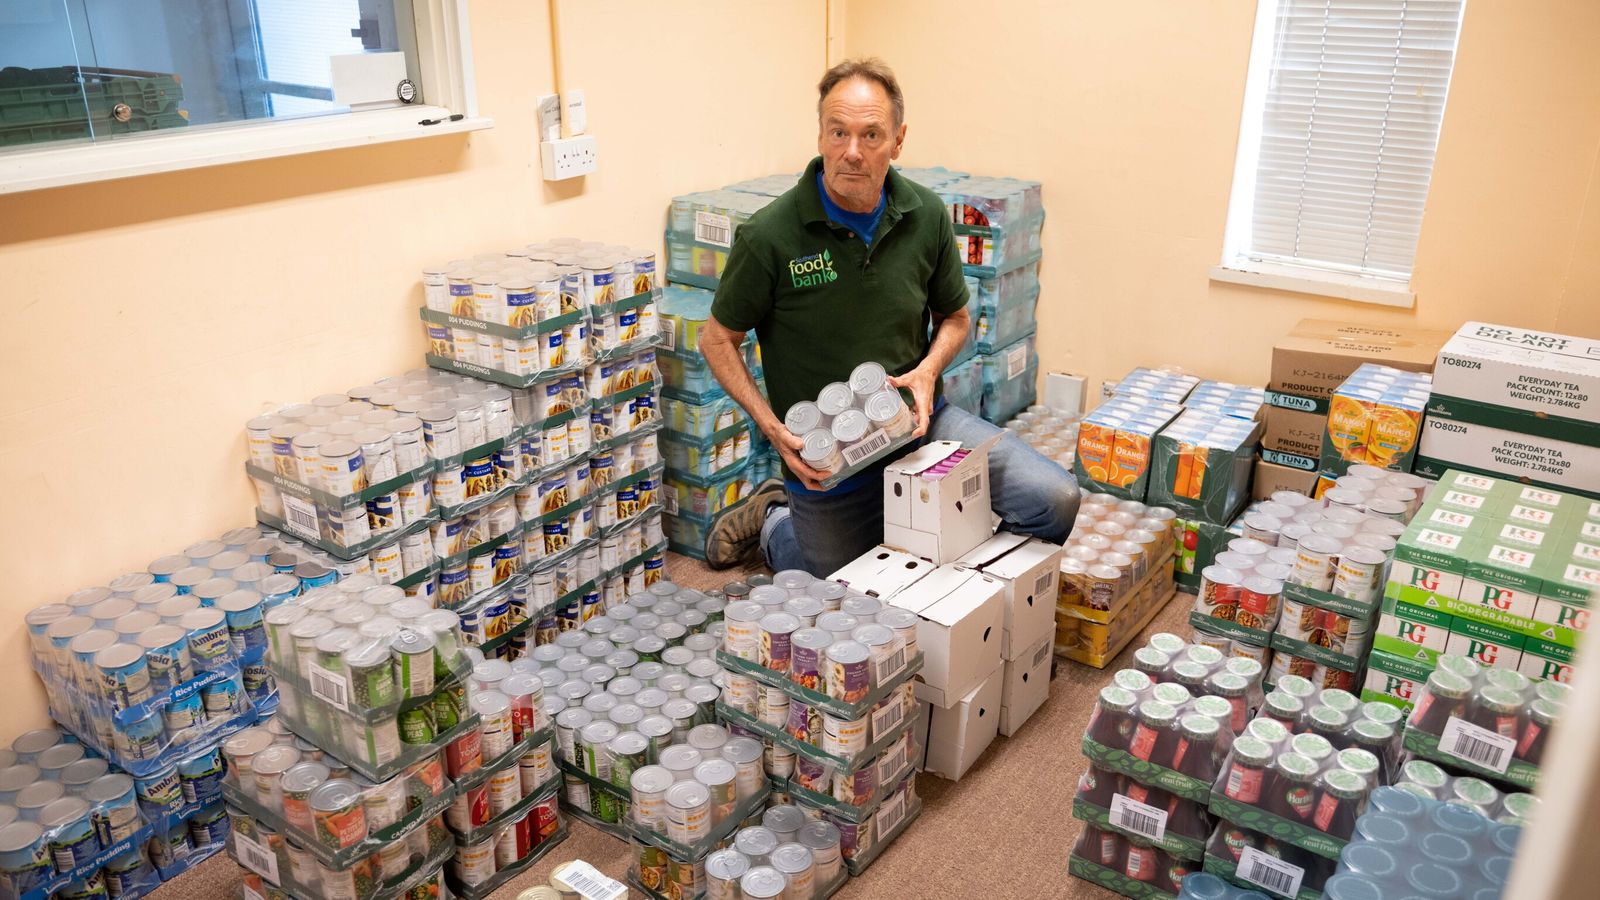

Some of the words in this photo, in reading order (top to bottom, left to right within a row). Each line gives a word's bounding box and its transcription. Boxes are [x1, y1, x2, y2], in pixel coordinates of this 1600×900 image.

[788, 254, 824, 274] food
[791, 268, 832, 288] bank
[458, 318, 487, 330] PUDDINGS
[1476, 331, 1568, 350] DECANT
[1480, 326, 1512, 336] DO
[1522, 333, 1572, 344] NOT
[463, 363, 490, 376] PUDDINGS
[1442, 356, 1482, 370] TO80274
[1282, 382, 1325, 394] PRODUCT
[1518, 375, 1561, 388] EVERYDAY
[1564, 382, 1580, 392] TEA
[1506, 382, 1528, 392] PACK
[1530, 386, 1563, 398] COUNT:
[1565, 392, 1588, 402] 12x80
[1510, 390, 1546, 403] WEIGHT:
[1548, 397, 1580, 409] 2.784KG
[1283, 396, 1310, 408] TUNA
[1429, 420, 1468, 434] TO80274
[1080, 437, 1110, 452] ORANGE
[1278, 438, 1320, 451] PRODUCT
[1503, 440, 1546, 454] EVERYDAY
[1548, 450, 1562, 458] TEA
[1116, 446, 1146, 460] ORANGE
[1281, 454, 1308, 466] TUNA
[1492, 446, 1512, 456] PACK
[1514, 450, 1546, 464] COUNT:
[1548, 458, 1570, 468] 12x80
[1494, 456, 1530, 468] WEIGHT:
[1531, 463, 1563, 475] 2.784KG
[284, 479, 311, 494] PUDDINGS
[1422, 554, 1452, 564] ORIGINAL
[1410, 566, 1440, 590] PG
[1495, 572, 1526, 584] ORIGINAL
[1481, 585, 1513, 610] PG
[1409, 608, 1439, 619] ORIGINAL
[1446, 600, 1536, 630] BIODEGRADABLE
[1556, 605, 1591, 632] PG
[1396, 620, 1426, 644] PG
[1480, 628, 1512, 640] ORIGINAL
[1466, 640, 1498, 664] PG
[1340, 658, 1354, 666] MEAT
[1395, 664, 1424, 676] ORIGINAL
[1540, 660, 1574, 683] PG
[175, 686, 193, 698] Rice
[193, 671, 226, 690] Pudding
[1384, 675, 1413, 698] PG
[407, 730, 424, 738] PEAS
[1161, 776, 1176, 784] real
[1176, 778, 1192, 788] fruit
[1304, 840, 1320, 849] real
[1320, 842, 1339, 854] fruit
[76, 862, 95, 877] Rice
[96, 842, 130, 865] Pudding
